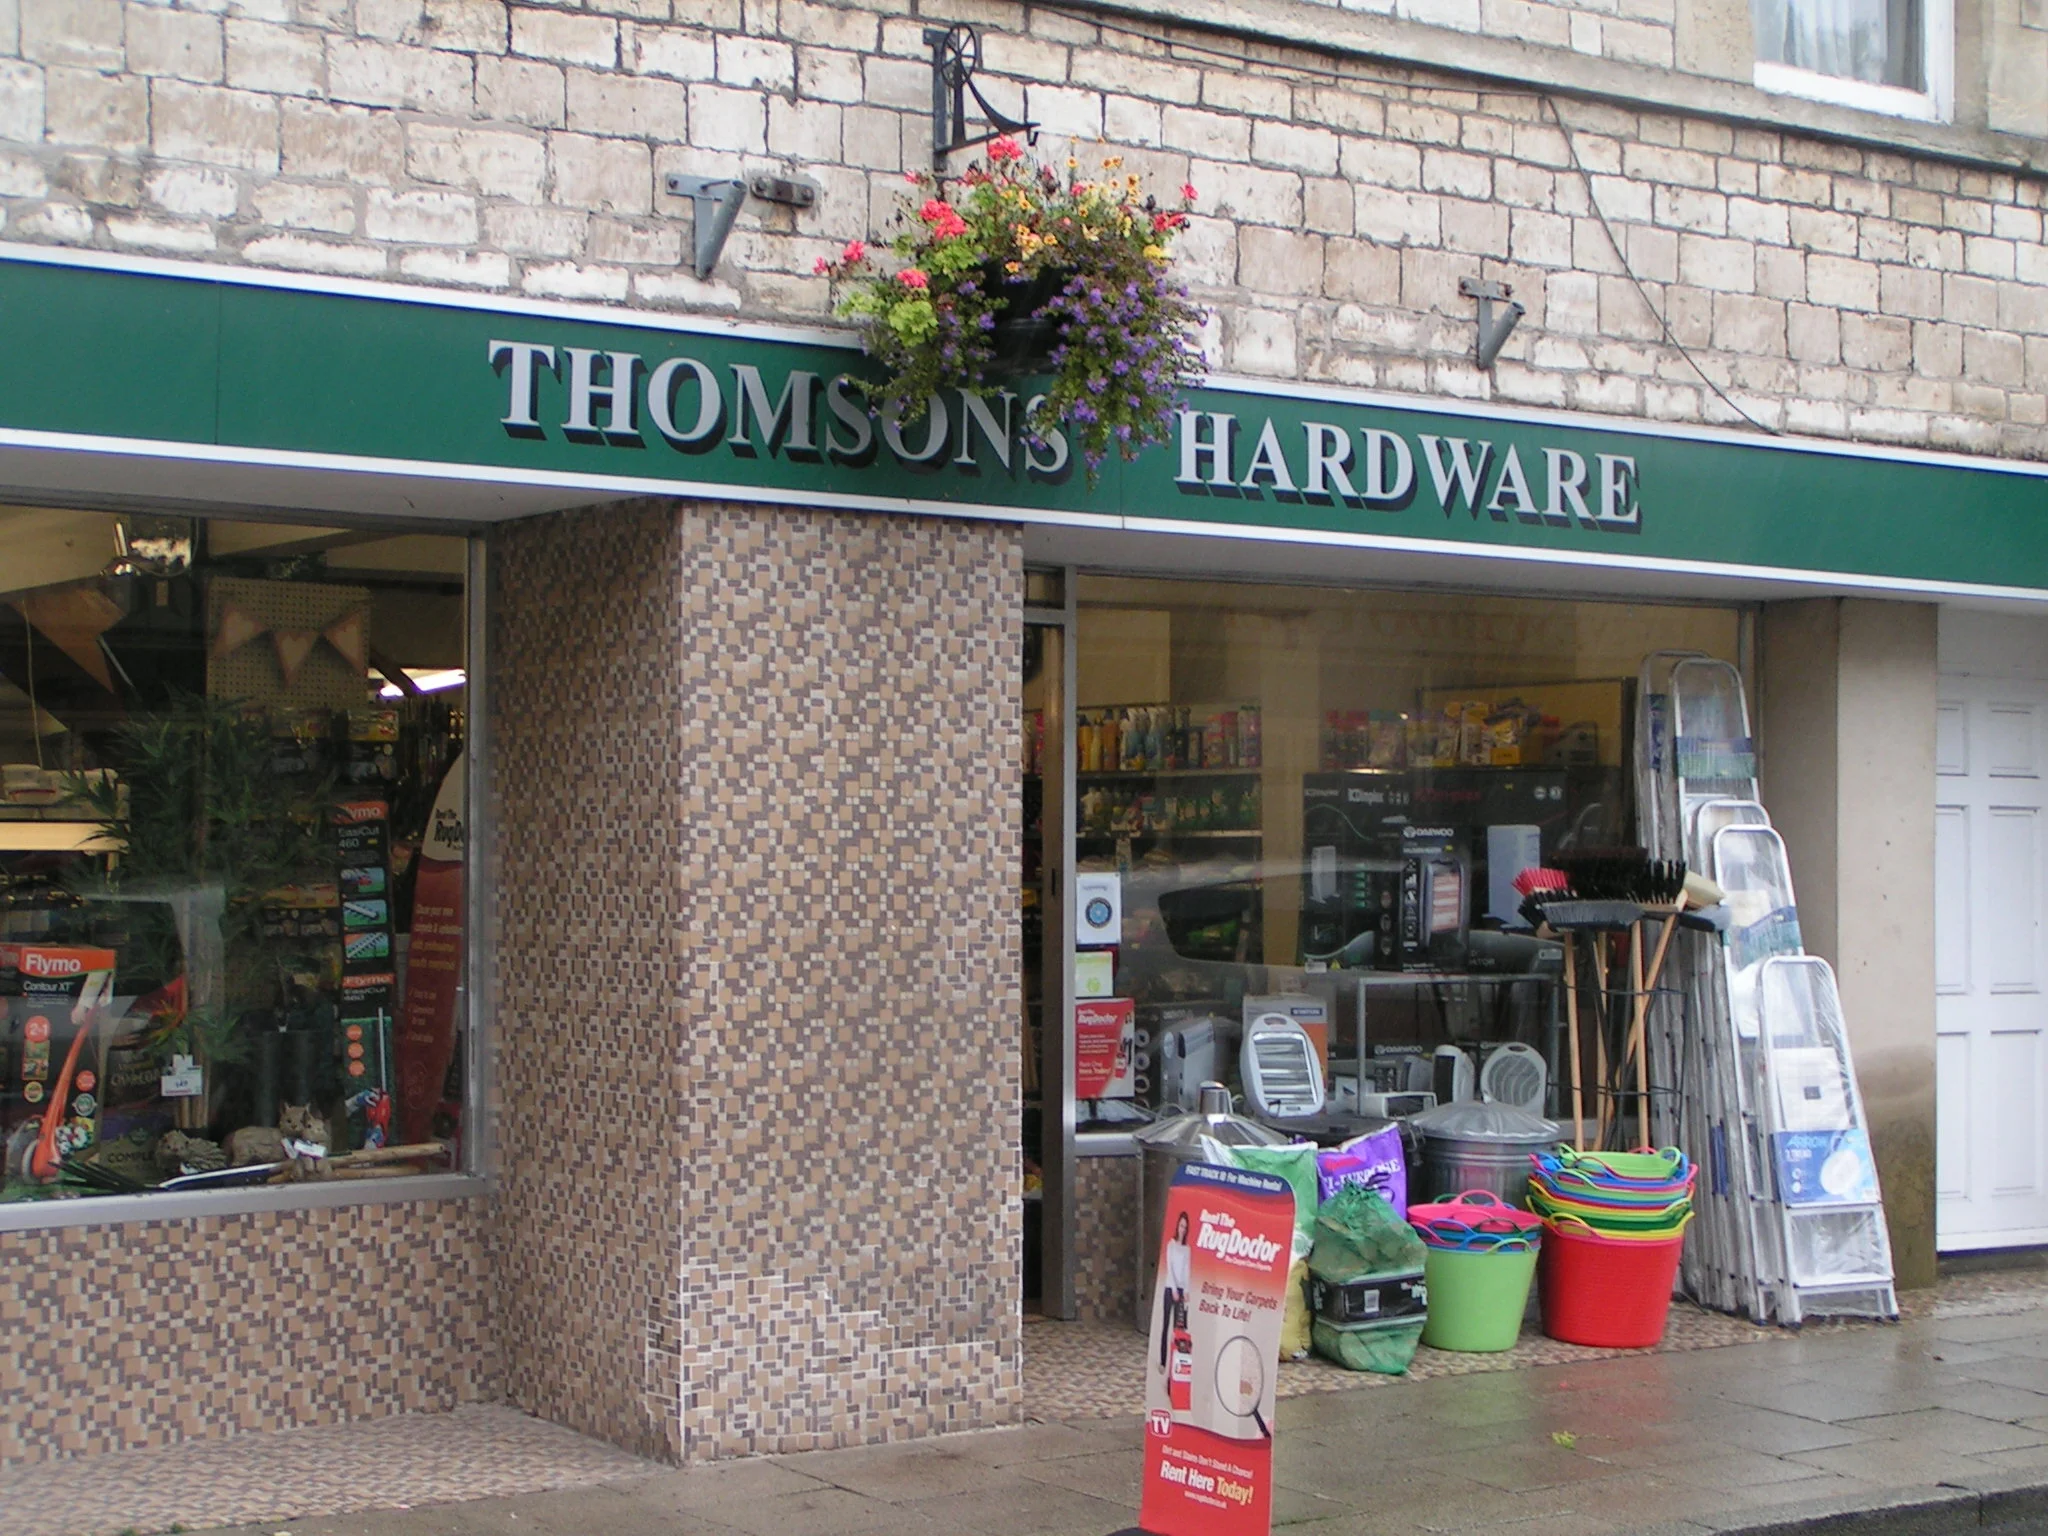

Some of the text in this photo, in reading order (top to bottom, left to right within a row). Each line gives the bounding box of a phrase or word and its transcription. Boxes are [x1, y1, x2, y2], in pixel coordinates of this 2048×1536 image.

[488, 338, 1640, 524] THOMSONS HARDWARE
[434, 820, 463, 848] RugD
[25, 953, 82, 975] Flymo
[23, 980, 58, 993] Contour
[1219, 1212, 1236, 1228] The
[1196, 1222, 1281, 1264] RugDoctor
[1199, 1299, 1219, 1315] Back
[1222, 1304, 1231, 1318] To
[1201, 1281, 1278, 1311] Bring Your Carpets
[1151, 1416, 1170, 1435] TV
[1160, 1460, 1254, 1506] Rent Here Today!
